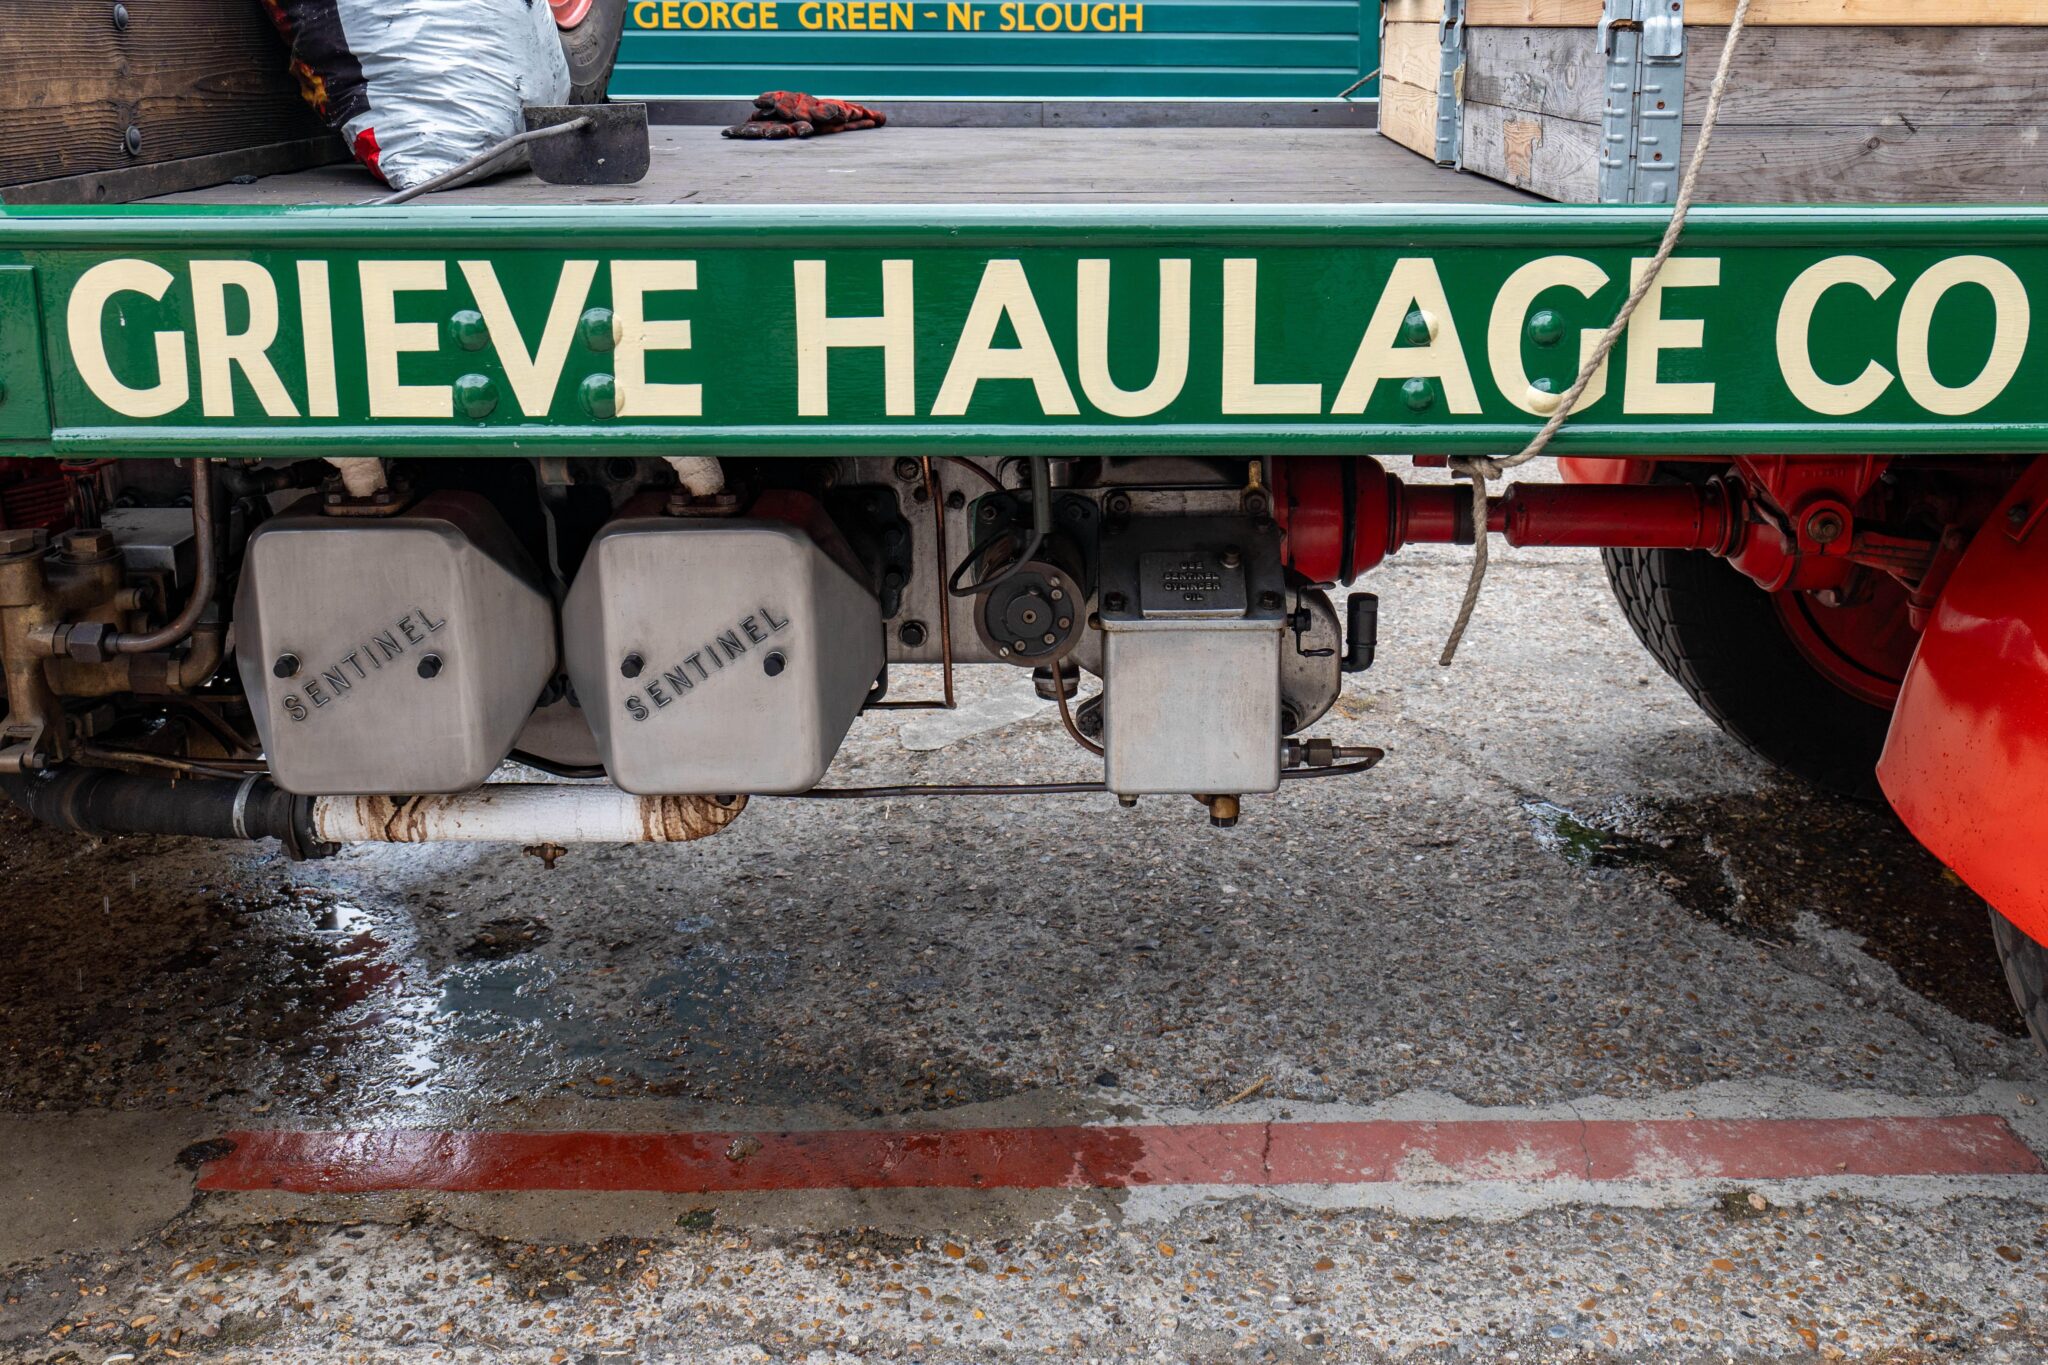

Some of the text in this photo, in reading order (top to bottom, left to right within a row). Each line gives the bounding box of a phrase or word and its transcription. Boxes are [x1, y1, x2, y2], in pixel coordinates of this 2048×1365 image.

[633, 1, 778, 29] GEORGE
[798, 2, 914, 30] GREEN
[947, 2, 985, 31] Nr
[1000, 2, 1143, 32] SLOUGH
[67, 254, 2031, 418] GRIEVE HAULAGE CO
[1164, 583, 1221, 591] CYLINDER
[281, 607, 448, 722] SENTINEL
[623, 607, 790, 722] SENTINEL
